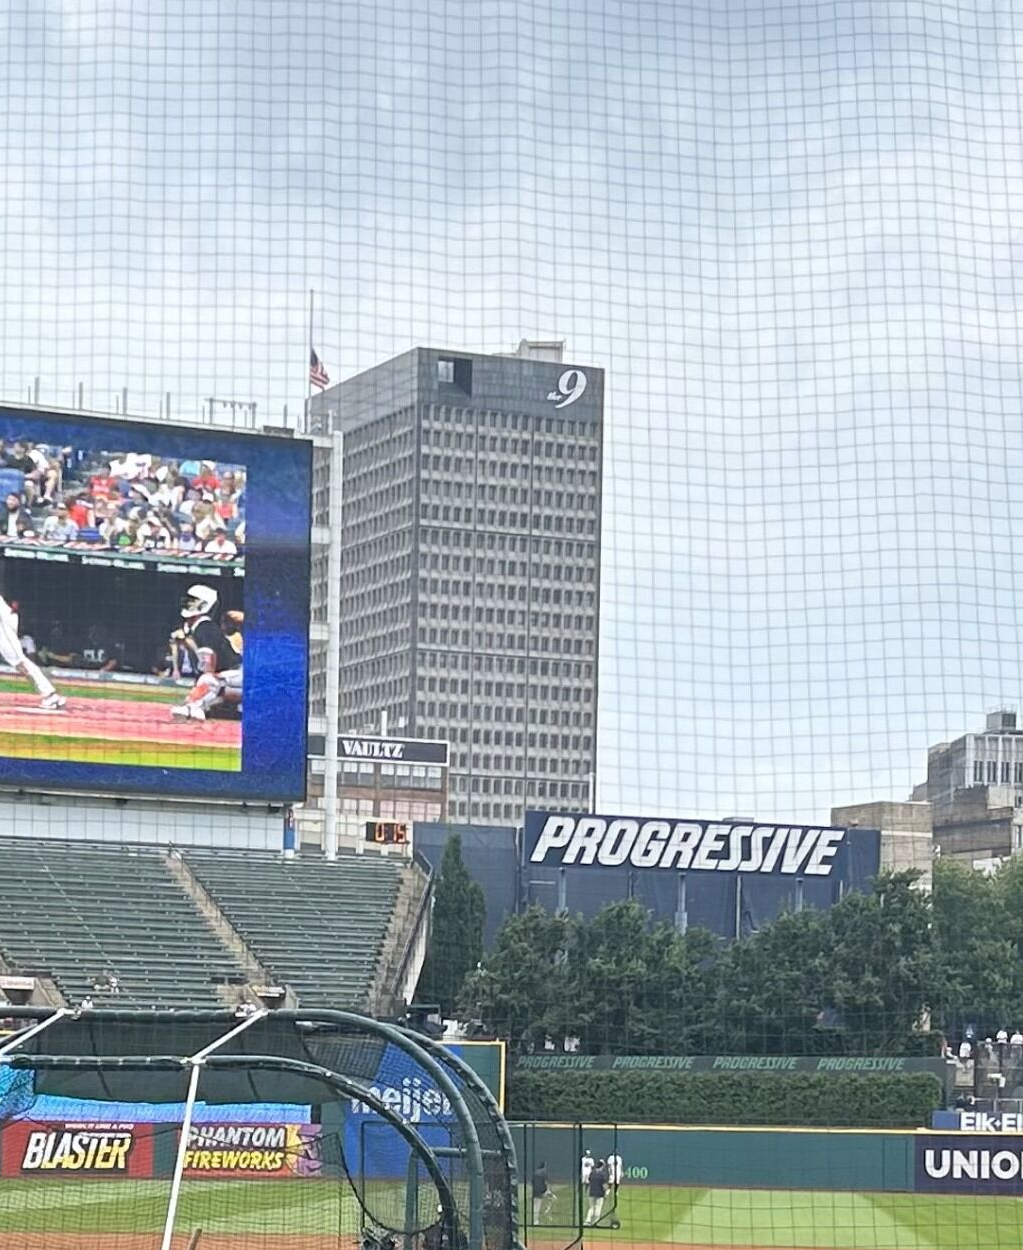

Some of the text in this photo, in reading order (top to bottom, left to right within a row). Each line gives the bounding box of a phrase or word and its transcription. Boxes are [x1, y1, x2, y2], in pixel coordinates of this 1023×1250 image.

[555, 369, 587, 409] 9
[342, 740, 404, 758] VAULTZ
[530, 816, 845, 876] PROGRESSIVE
[516, 1055, 596, 1069] PROGRESSIVE
[612, 1055, 694, 1069] PROGRESSIVE
[713, 1056, 797, 1070] PROGRESSIVE
[817, 1057, 905, 1071] PROGRESSIVE
[188, 1126, 285, 1148] PHANTOM
[22, 1132, 133, 1169] BLASTER
[184, 1151, 284, 1170] FIREWORKS
[925, 1150, 1023, 1179] UNIO
